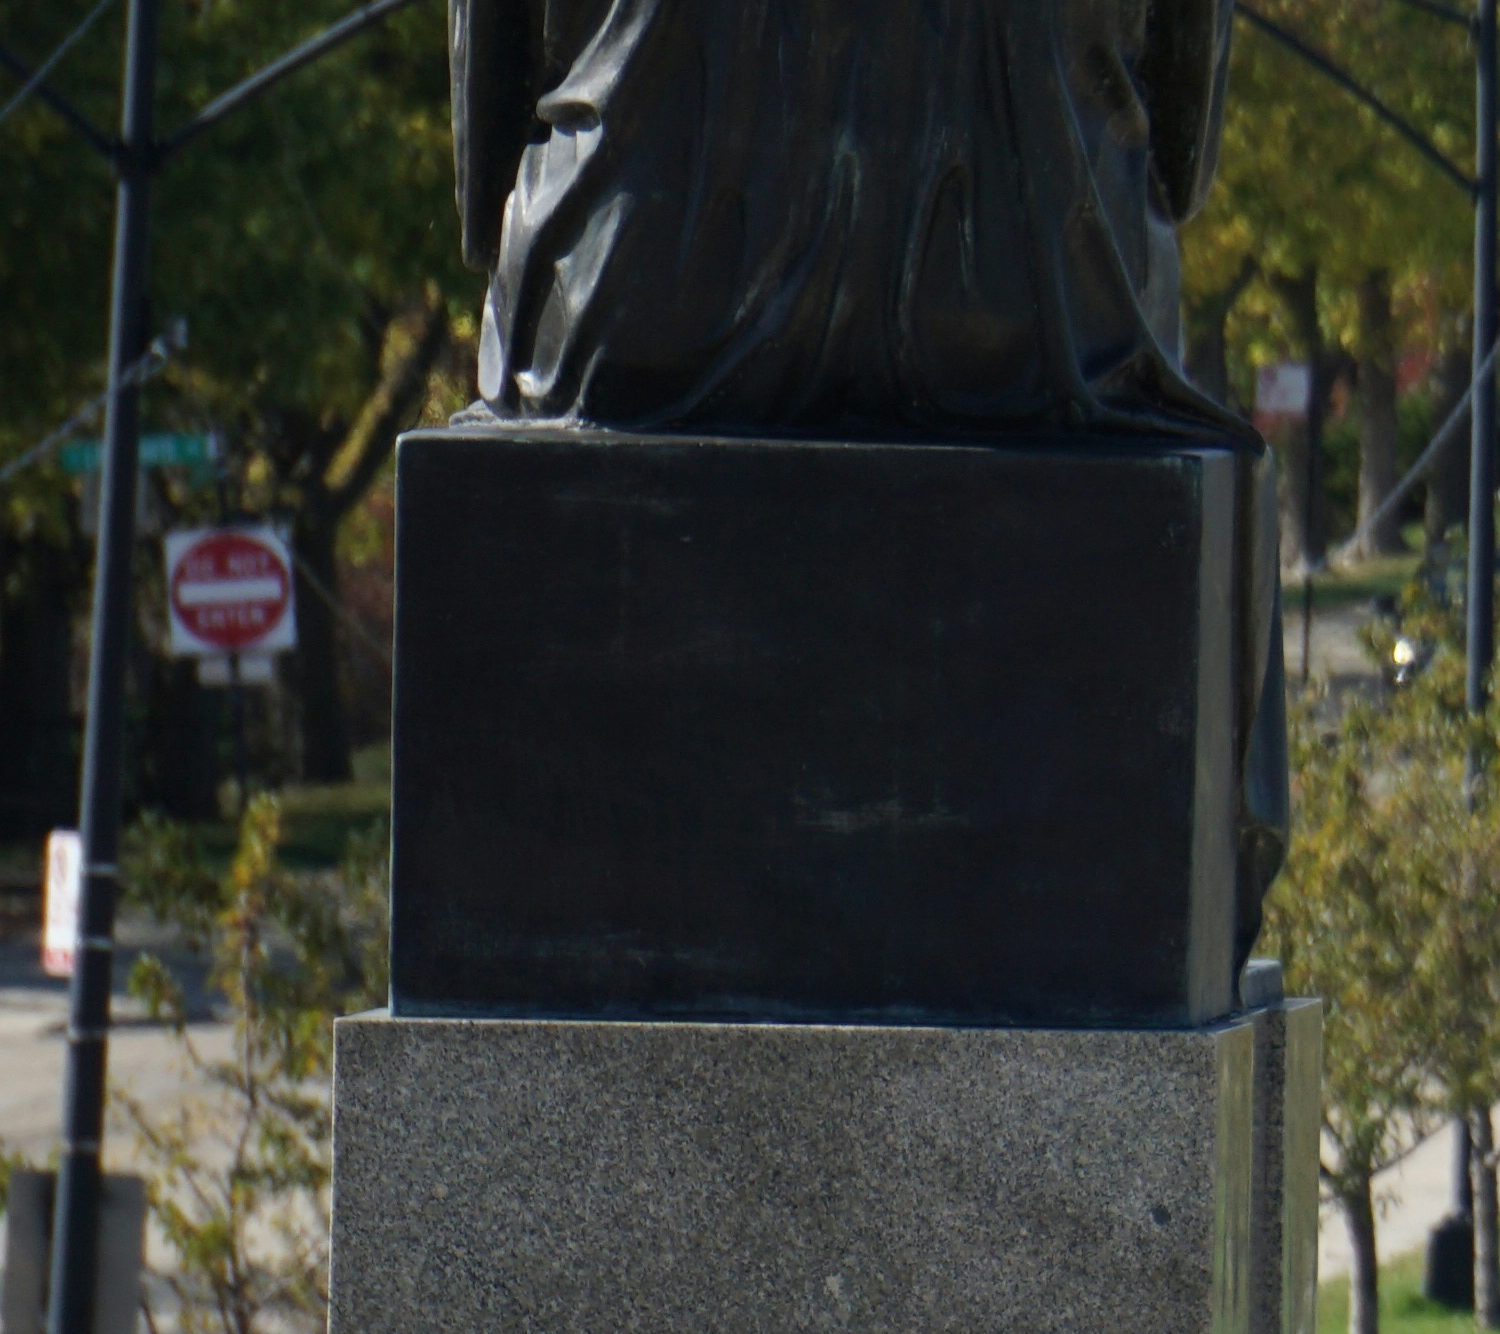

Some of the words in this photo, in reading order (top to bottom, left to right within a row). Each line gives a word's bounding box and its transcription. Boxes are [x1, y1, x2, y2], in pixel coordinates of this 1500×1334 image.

[186, 554, 215, 578] DO
[228, 551, 268, 576] NOT
[197, 606, 265, 628] ENTER
